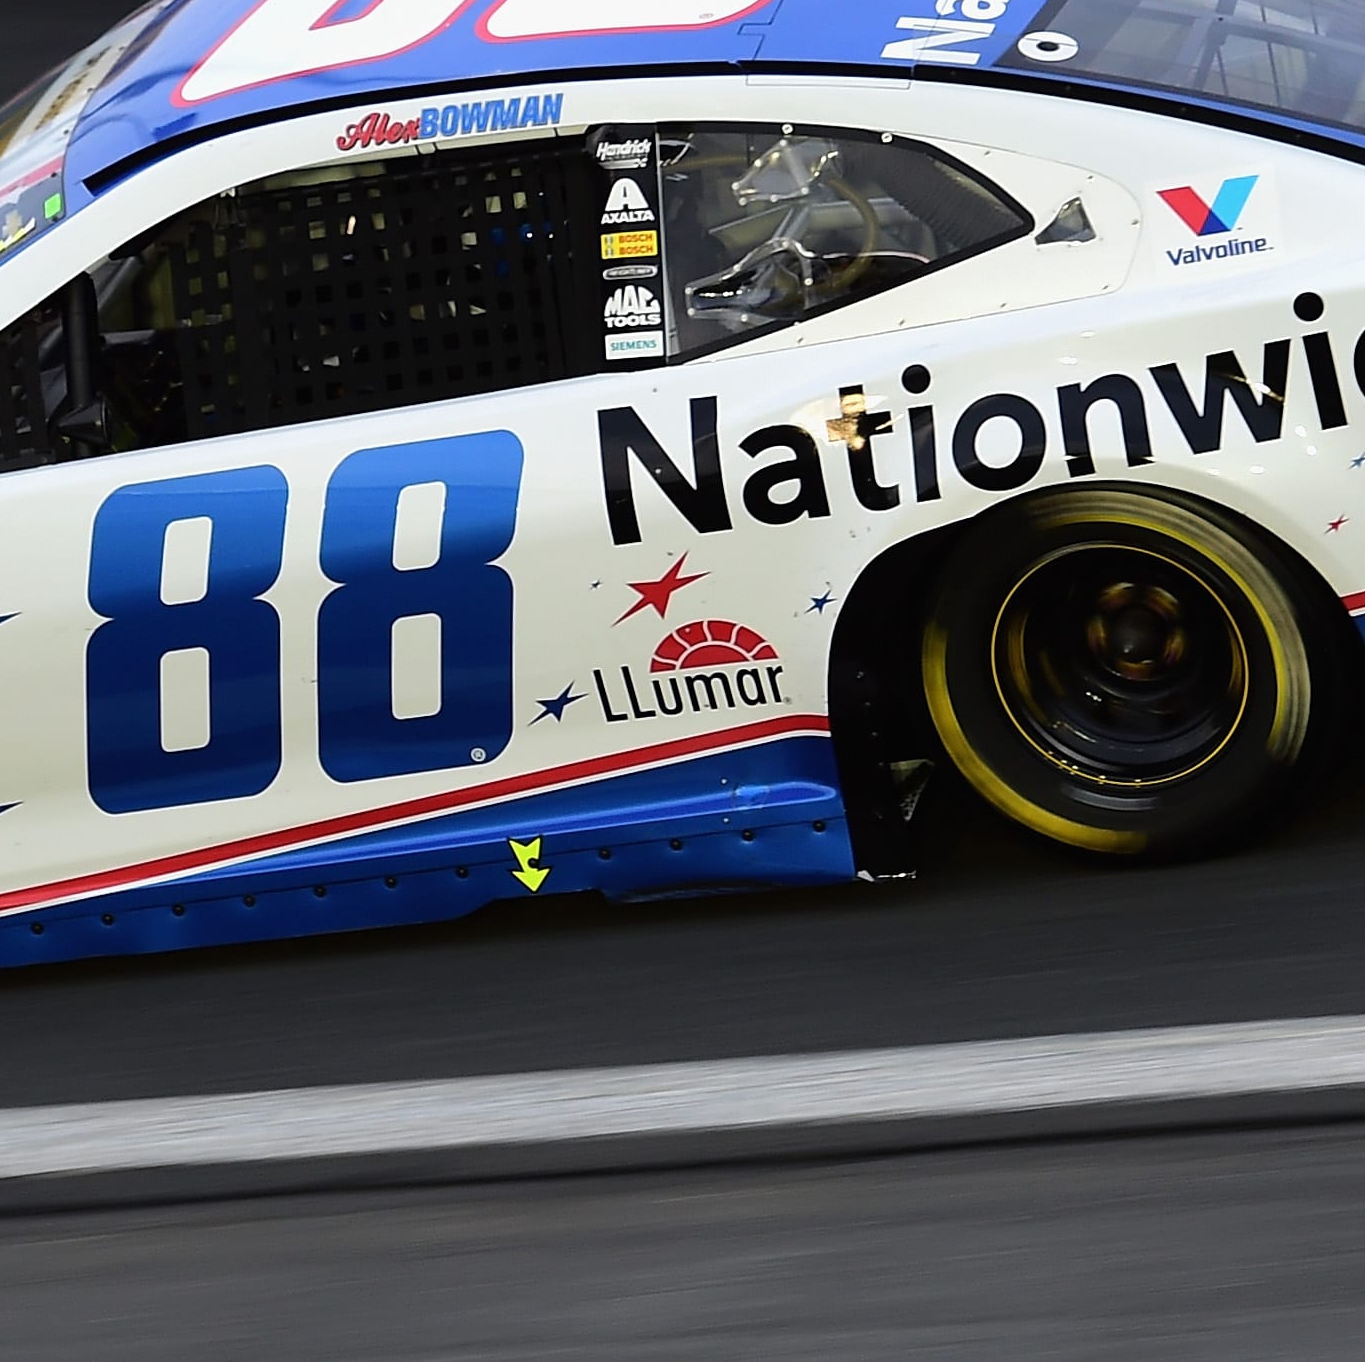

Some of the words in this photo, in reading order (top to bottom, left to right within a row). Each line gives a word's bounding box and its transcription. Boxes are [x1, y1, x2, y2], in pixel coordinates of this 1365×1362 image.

[337, 112, 421, 151] Alex
[418, 92, 564, 139] BOWMAN
[596, 138, 652, 162] Hendrick
[600, 209, 656, 226] AXALTA
[618, 233, 653, 244] BOSCH
[618, 245, 654, 256] BOSCH
[1166, 235, 1270, 268] Valvoline
[604, 284, 661, 318] MAC
[604, 314, 662, 329] TOOLS
[610, 339, 658, 352] SIEMENS
[85, 428, 524, 815] 88
[593, 665, 784, 723] LLumar
